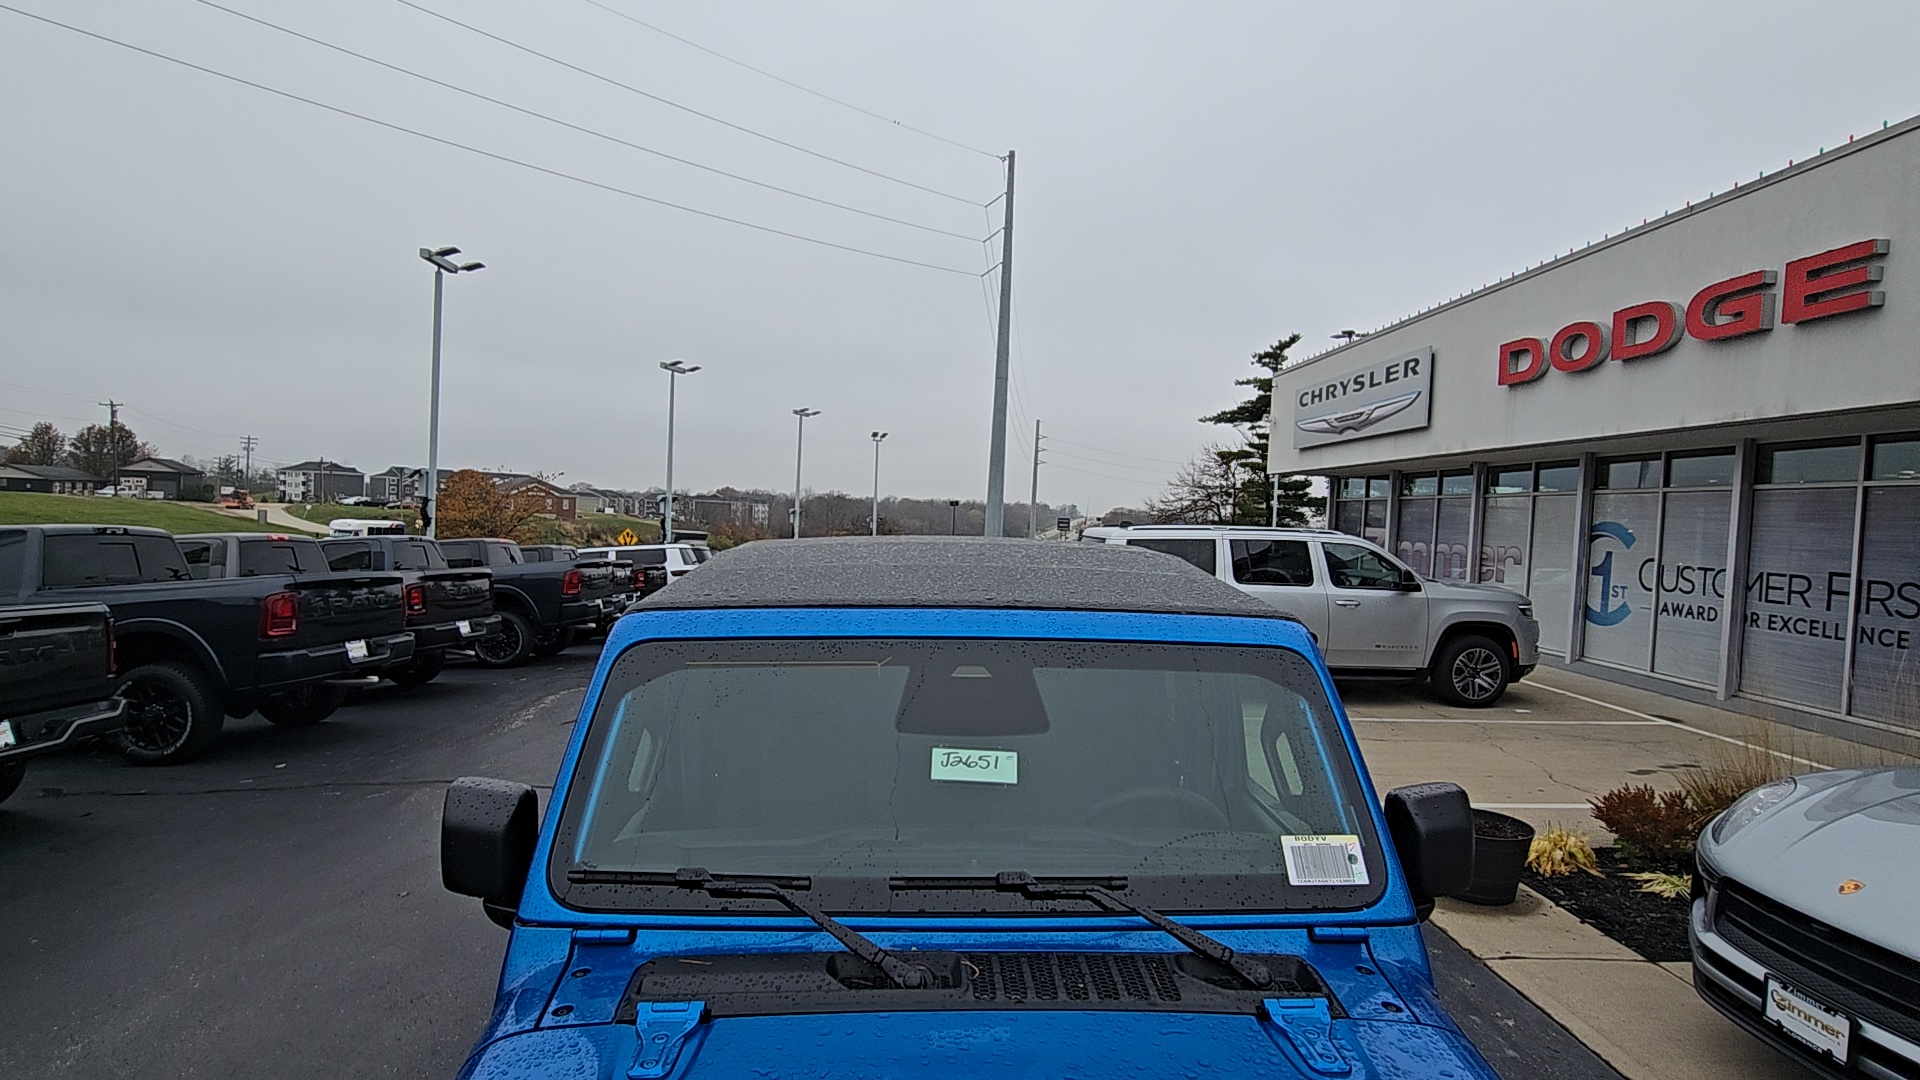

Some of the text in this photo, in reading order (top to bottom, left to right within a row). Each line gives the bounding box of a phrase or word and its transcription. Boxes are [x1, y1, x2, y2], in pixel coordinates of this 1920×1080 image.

[1498, 239, 1889, 387] DODGE
[1299, 358, 1420, 407] CHRYSLER
[328, 594, 386, 613] RAM
[1659, 602, 1719, 622] AWARD
[1767, 614, 1911, 650] EXCELLNCE
[940, 751, 999, 770] J2651
[1771, 989, 1846, 1040] Zimmer
